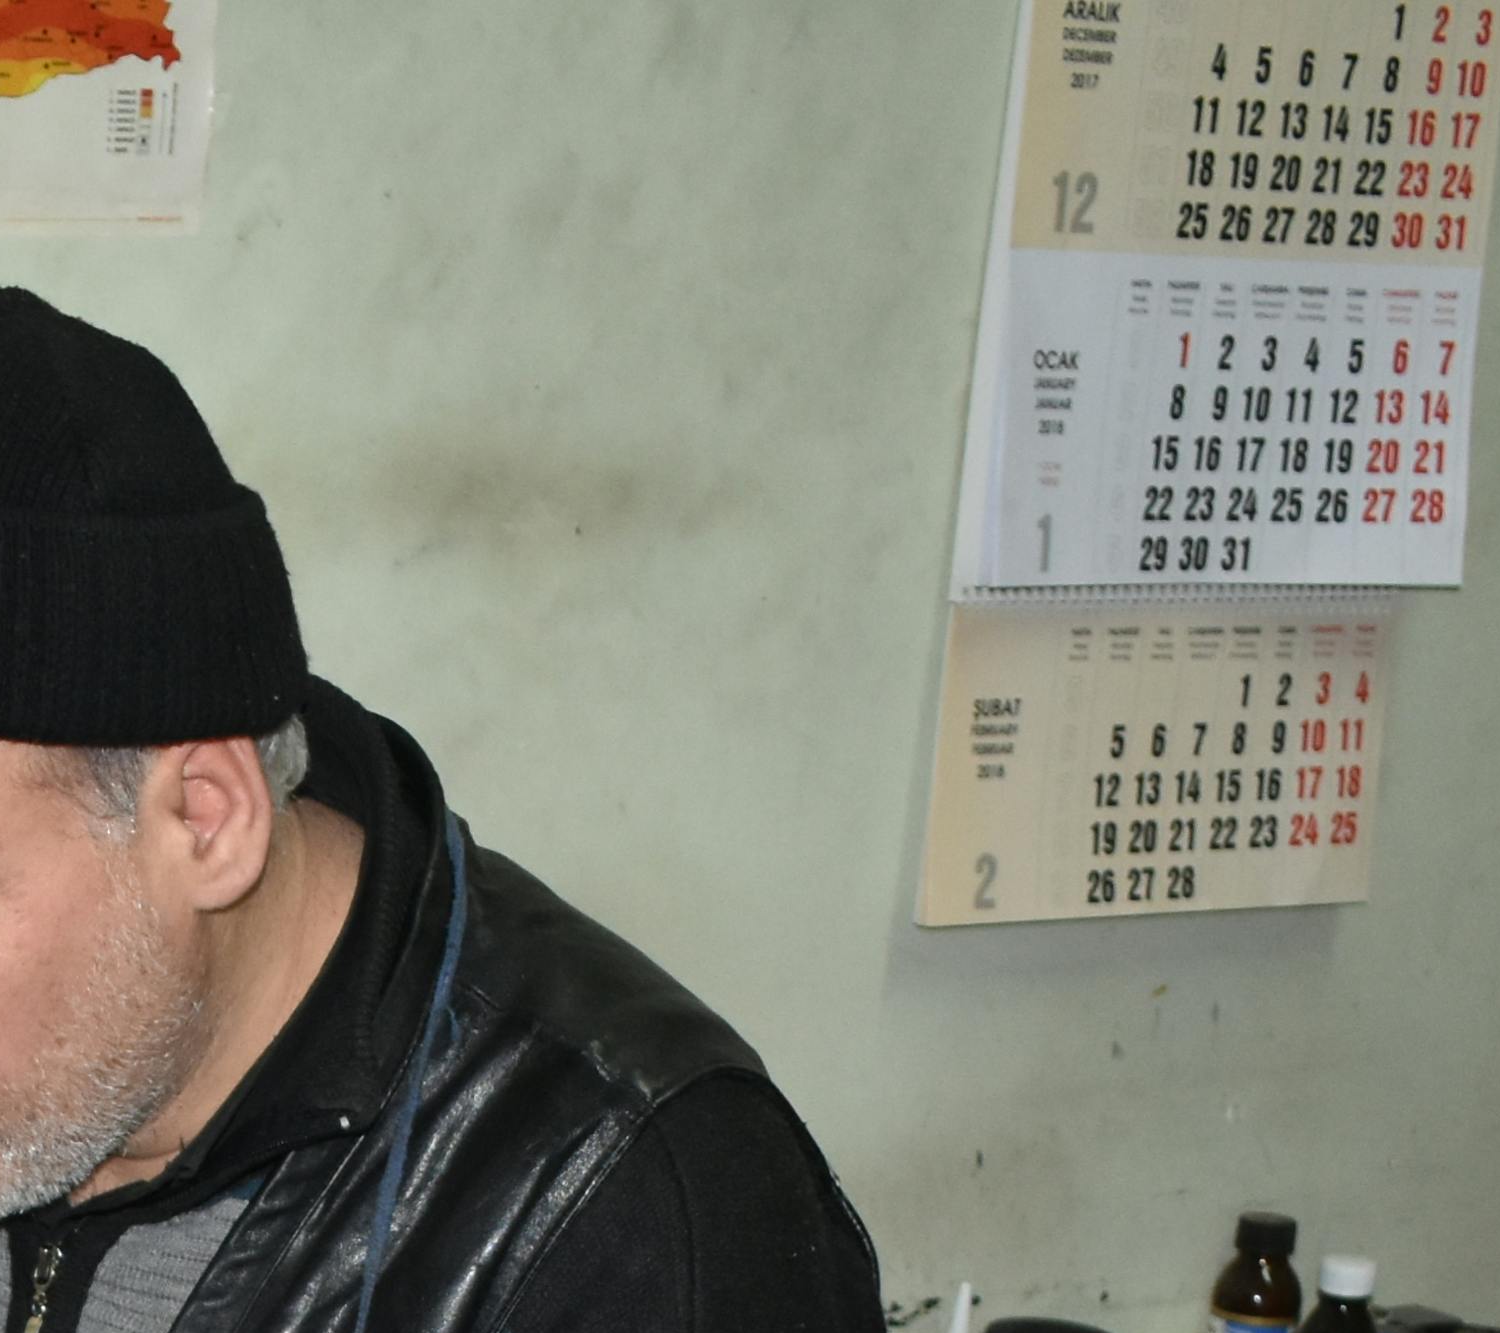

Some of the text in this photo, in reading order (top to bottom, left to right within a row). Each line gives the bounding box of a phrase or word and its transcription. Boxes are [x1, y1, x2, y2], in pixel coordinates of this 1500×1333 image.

[1063, 0, 1121, 22] ARALIK
[1395, 3, 1493, 47] 1 2 3
[1211, 43, 1487, 99] 4 5 6 7 8 9 10
[1193, 95, 1481, 149] 11 12 13 14 15 16 17
[1187, 149, 1473, 200] 18 19 20 21 22 23 24
[1052, 171, 1096, 234] 12
[1176, 201, 1466, 251] 25 26 27 28 29 30 31
[1034, 349, 1080, 370] OCAK
[1179, 332, 1456, 376] 1 2 3 4 5 6 7
[1169, 383, 1450, 425] 8 9 10 11 12 13 14
[1152, 435, 1445, 475] 15 16 17 18 19 20 21
[1143, 485, 1444, 524] 22 23 24 25 26 27 28
[1139, 535, 1251, 572] 29 30 31
[973, 698, 1022, 720] ŞUBAT
[1241, 670, 1370, 708] 1 2 3 4
[1110, 718, 1364, 760] 5 6 7 8 9 10 11
[1094, 764, 1362, 808] 12 13 14 15 16 17 18
[1090, 811, 1358, 856] 19 20 21 22 23 24 25
[975, 853, 998, 908] 2
[1087, 865, 1195, 904] 26 27 28
